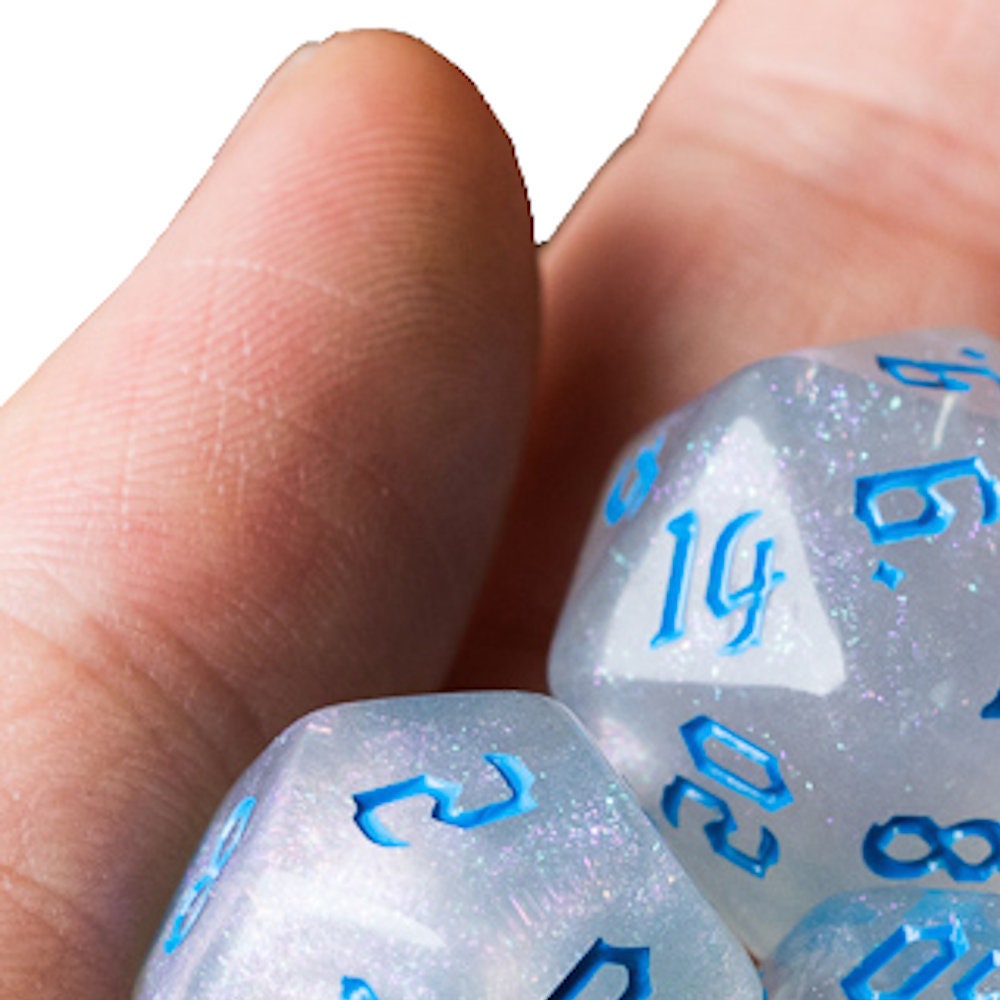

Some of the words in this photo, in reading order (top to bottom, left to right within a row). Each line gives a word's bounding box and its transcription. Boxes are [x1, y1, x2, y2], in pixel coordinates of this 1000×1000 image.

[649, 507, 788, 656] 14
[352, 752, 540, 848] 2
[661, 712, 796, 880] 20
